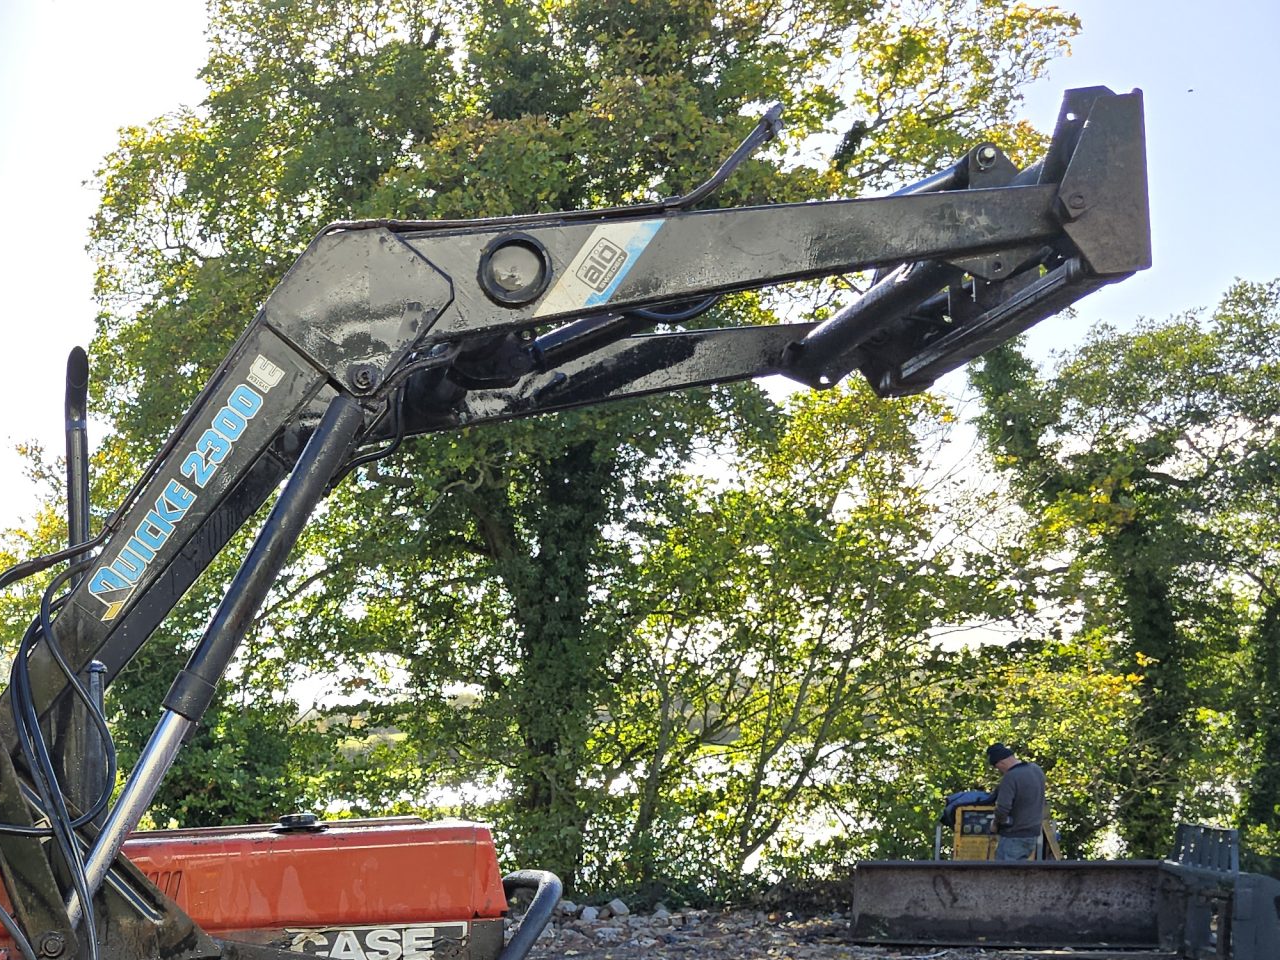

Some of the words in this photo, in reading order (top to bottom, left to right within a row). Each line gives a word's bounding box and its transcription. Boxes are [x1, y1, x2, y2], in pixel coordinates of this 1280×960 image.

[598, 254, 625, 289] SWEDEN
[88, 478, 197, 622] QUICKE
[180, 383, 263, 488] 2300
